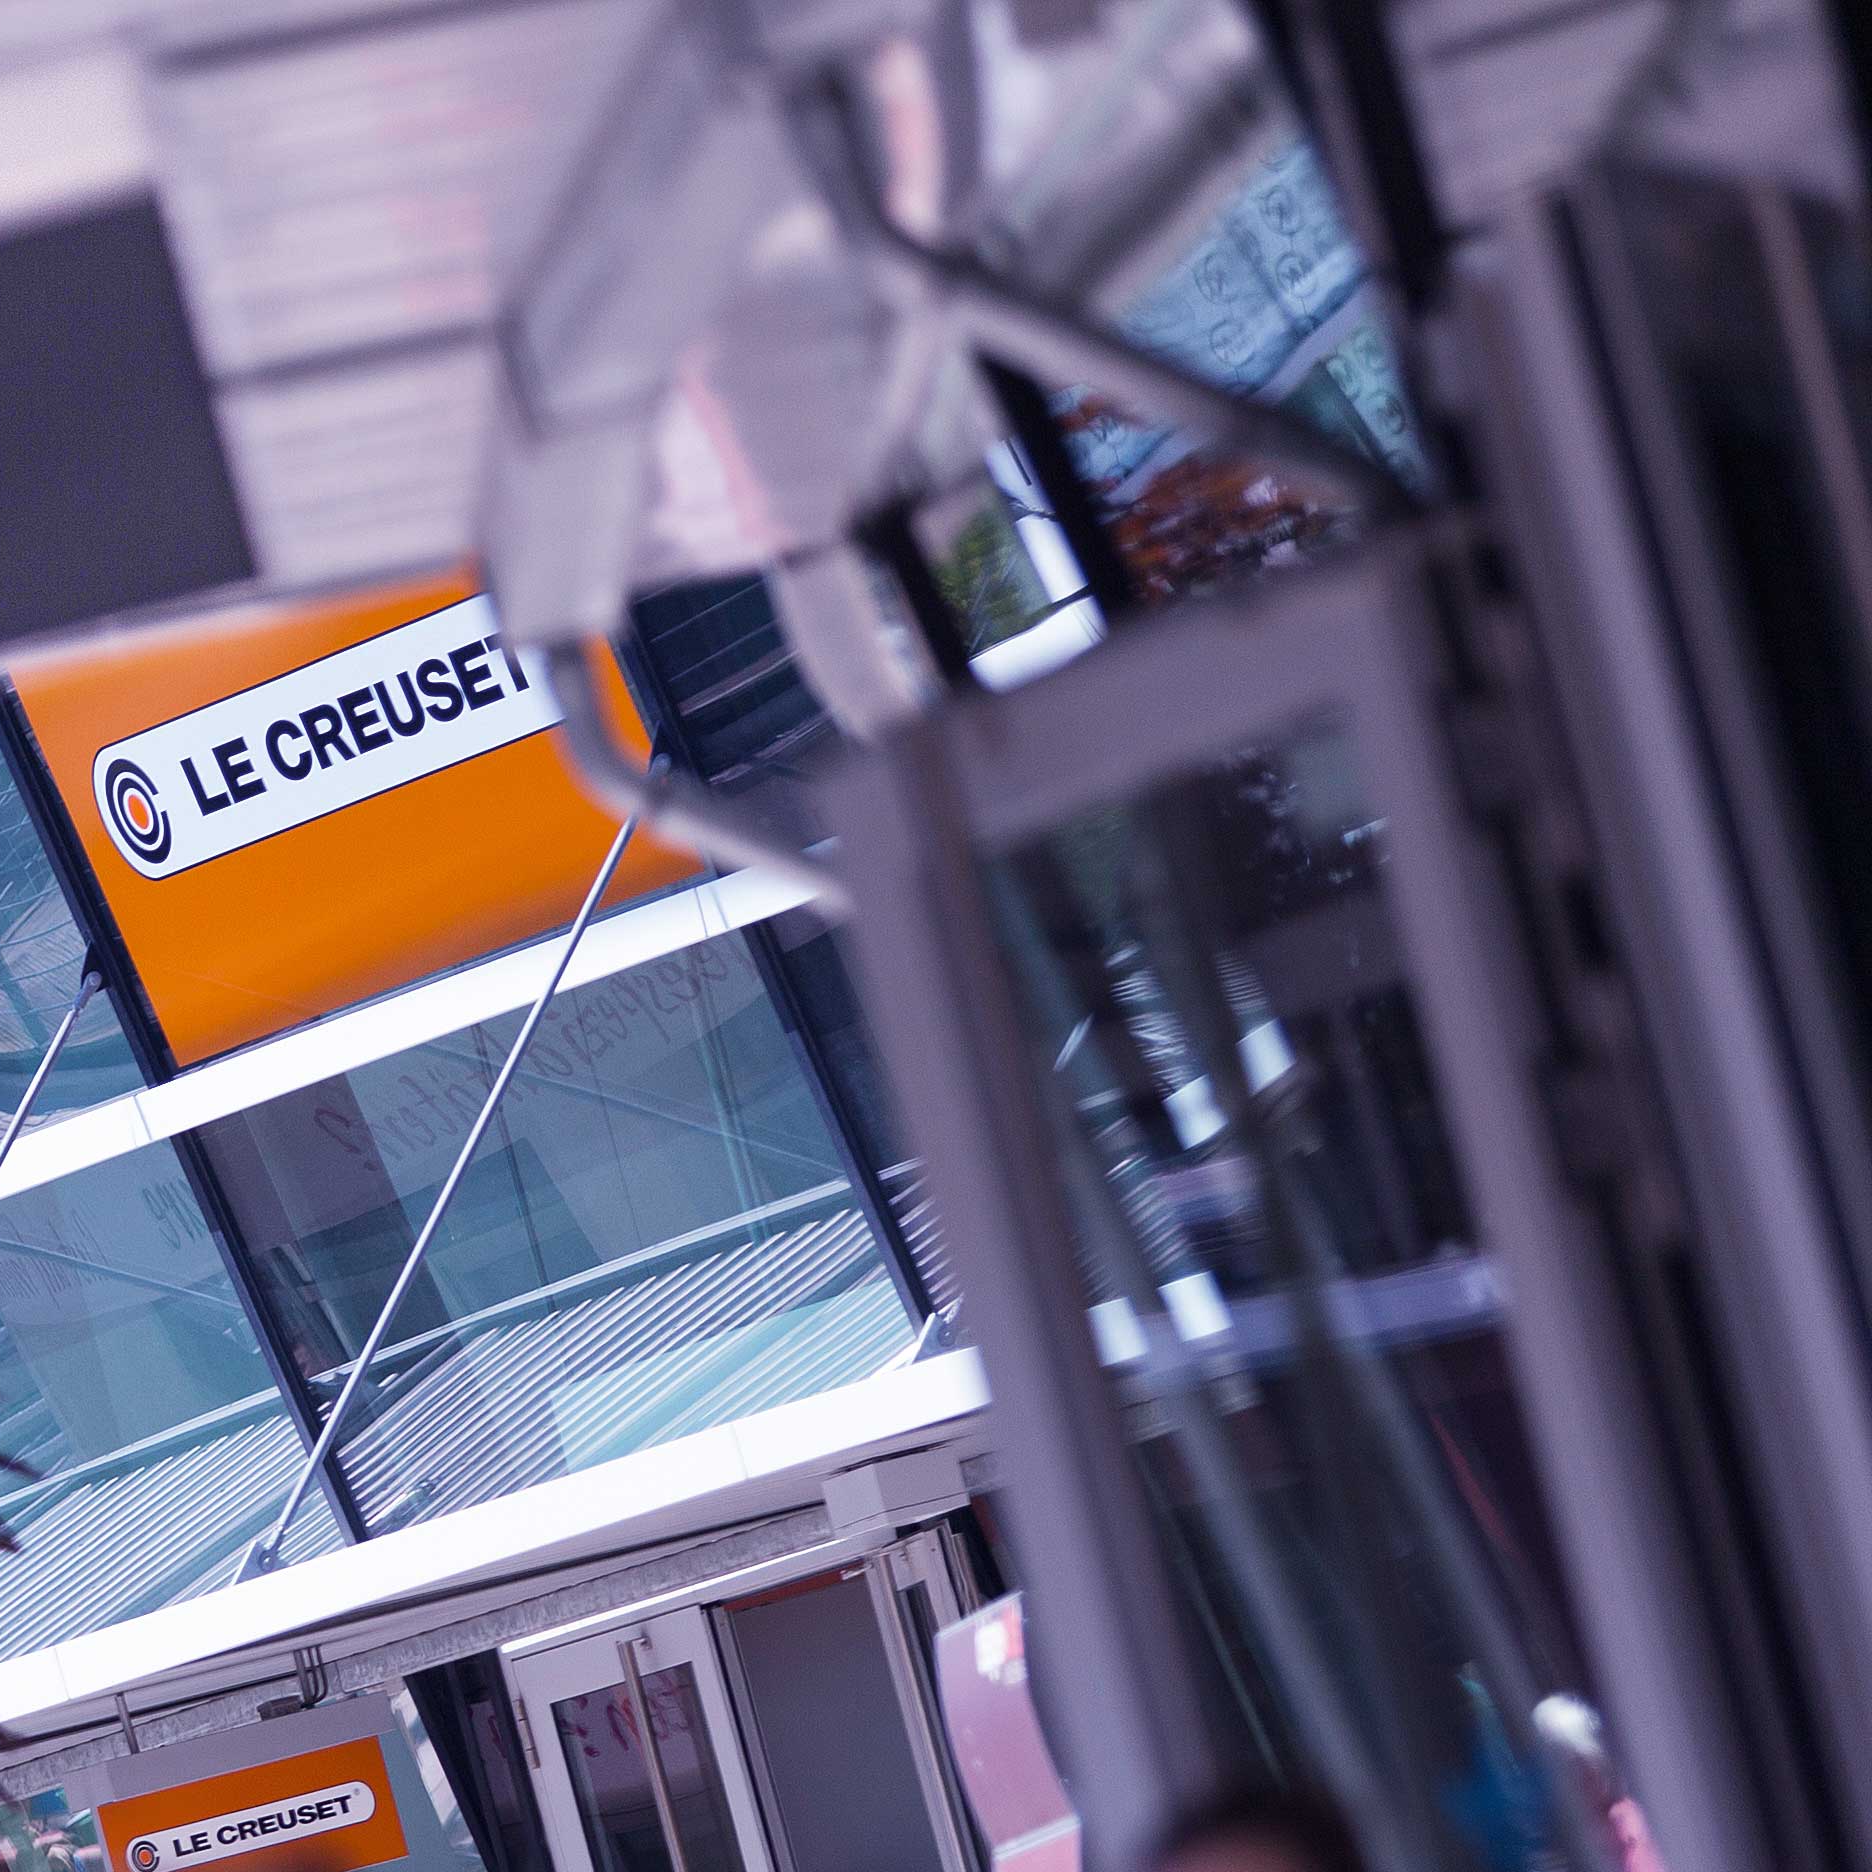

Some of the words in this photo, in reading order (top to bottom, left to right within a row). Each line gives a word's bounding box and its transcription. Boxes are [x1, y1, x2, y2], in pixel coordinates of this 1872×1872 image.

[179, 736, 266, 817] LE
[173, 1831, 211, 1858] LE
[216, 1794, 352, 1844] CREUSET
